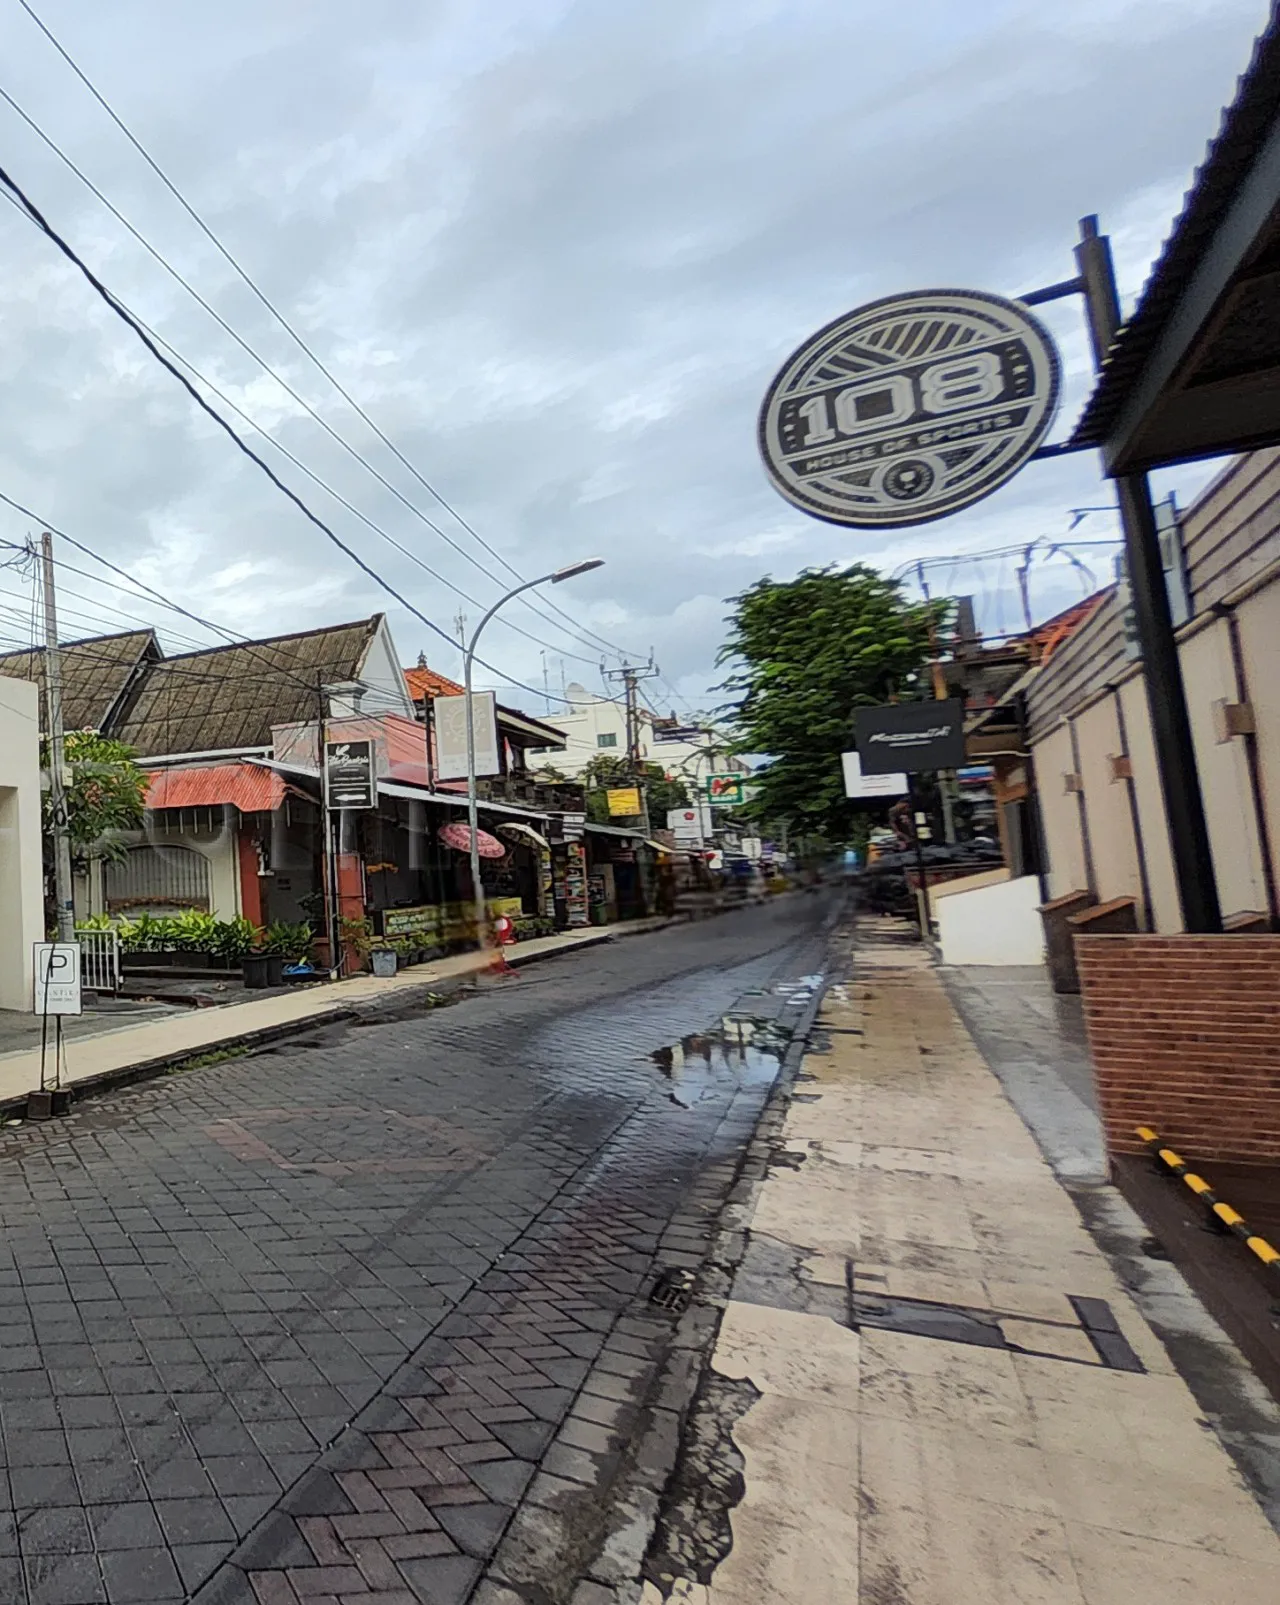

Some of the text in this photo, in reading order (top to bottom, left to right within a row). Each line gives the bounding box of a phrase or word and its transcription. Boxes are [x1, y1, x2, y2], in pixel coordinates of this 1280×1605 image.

[799, 352, 1004, 446] 108
[806, 415, 1012, 471] HOUSE OF SPORTS
